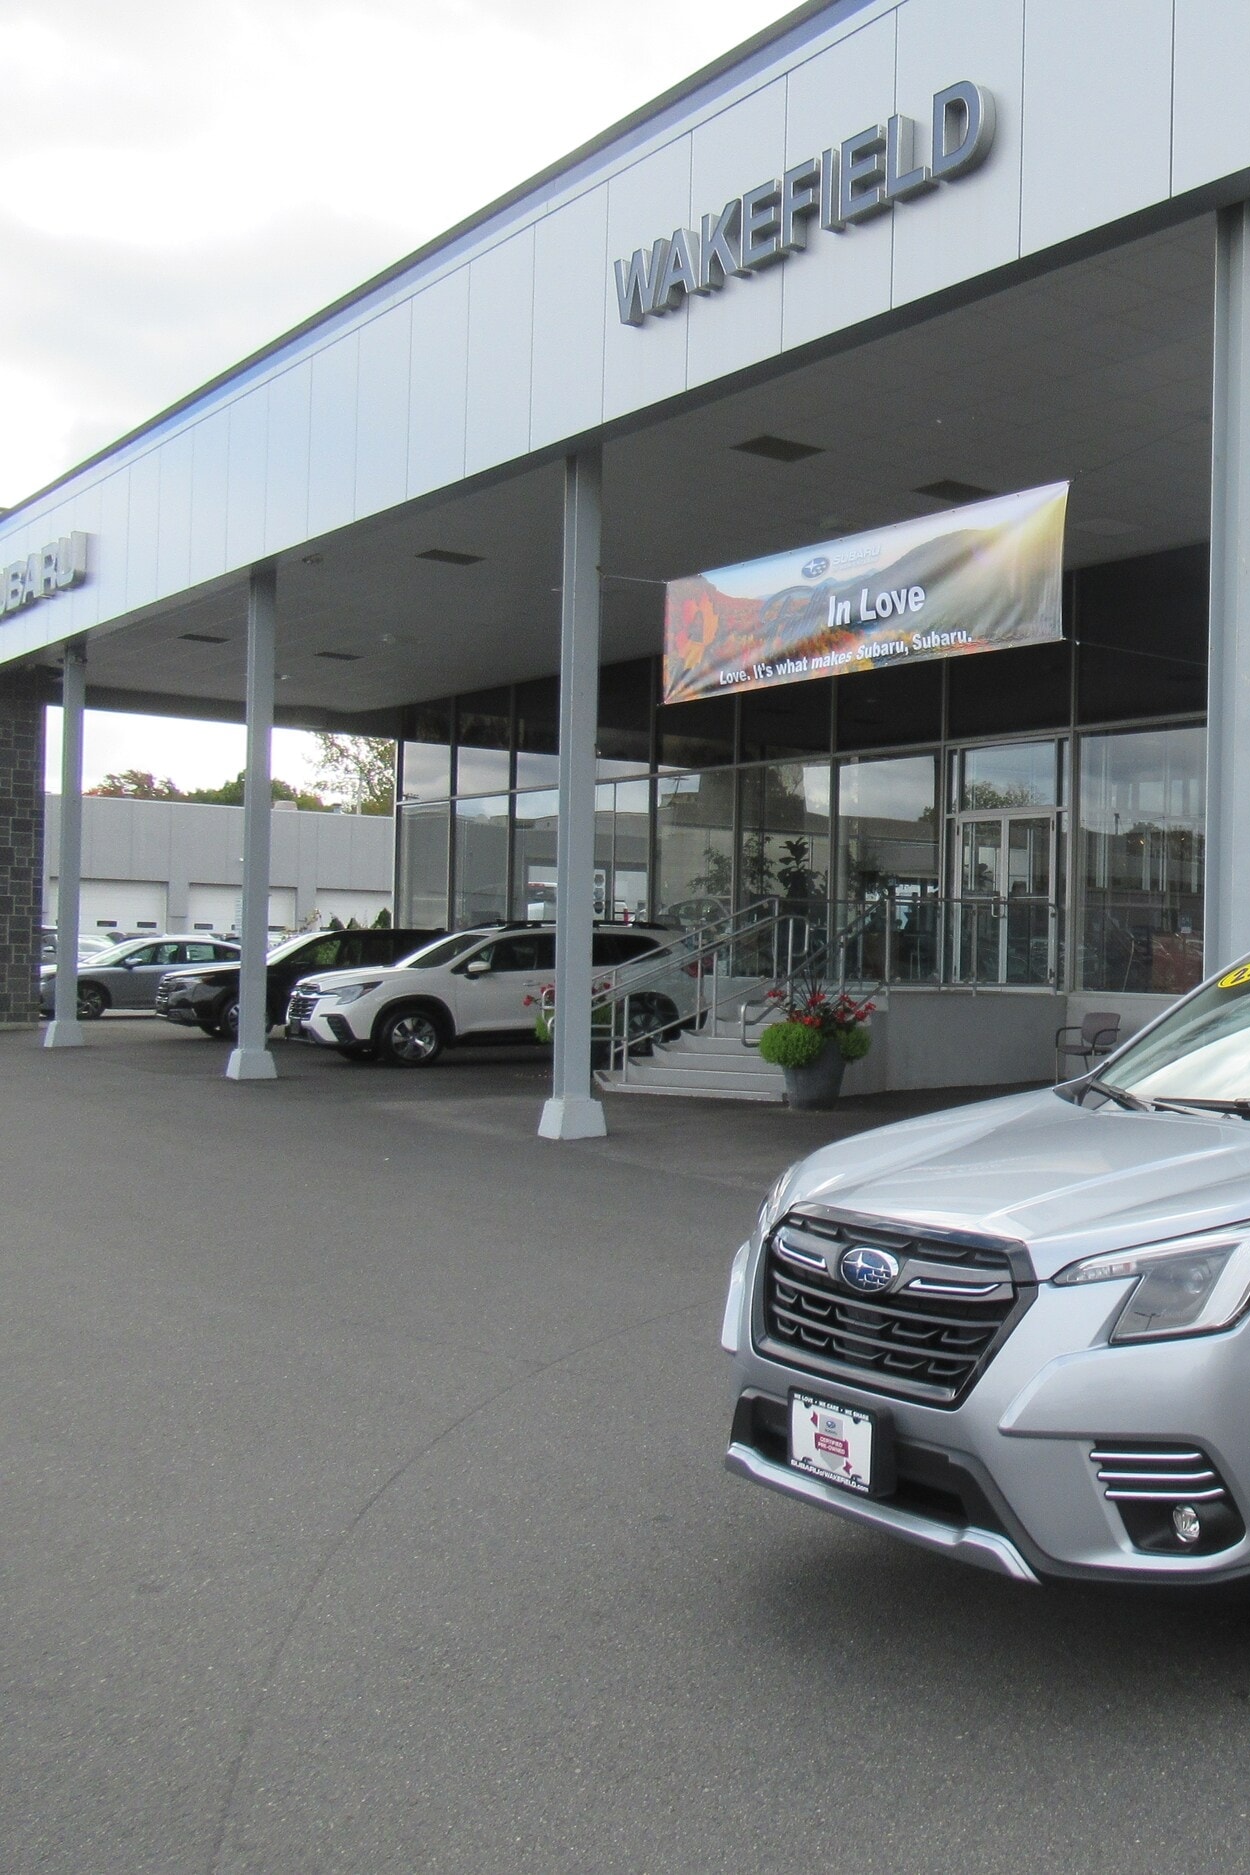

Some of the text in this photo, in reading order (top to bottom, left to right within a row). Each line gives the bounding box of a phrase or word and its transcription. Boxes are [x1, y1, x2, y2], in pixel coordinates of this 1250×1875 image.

[613, 80, 997, 328] WAKEFIELD
[0, 531, 87, 616] BARU
[833, 544, 881, 565] SUBARU
[828, 595, 851, 628] In
[860, 584, 926, 623] Love
[719, 629, 973, 686] Love. It's what makes Subaru, Subaru.
[817, 1441, 846, 1455] PRE-OWNED
[819, 1436, 843, 1448] CERTIFIED
